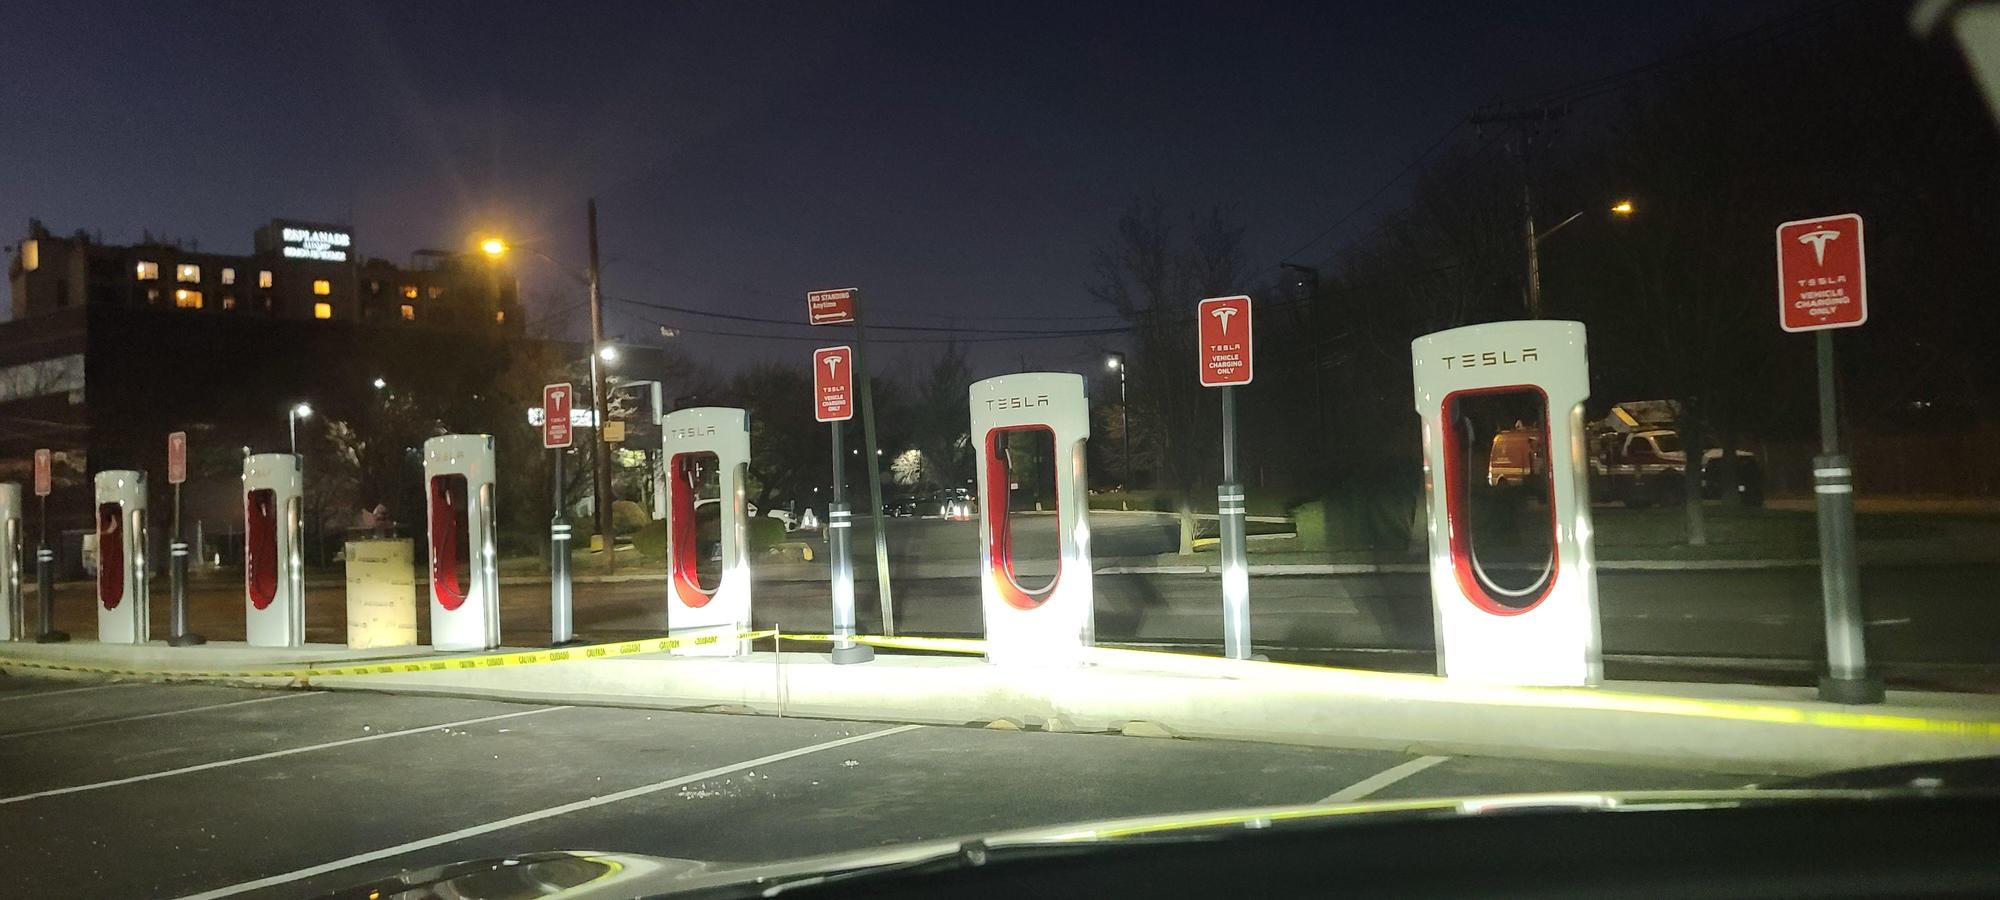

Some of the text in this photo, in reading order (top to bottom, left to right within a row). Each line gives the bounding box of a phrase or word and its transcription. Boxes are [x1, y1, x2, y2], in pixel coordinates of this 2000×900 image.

[283, 228, 350, 247] ESPLANADE
[1798, 275, 1846, 287] TESLA
[821, 292, 850, 301] STANDING
[1800, 289, 1844, 300] VEHICLE
[1795, 297, 1850, 309] CHARGING
[1809, 306, 1837, 316] ONLY
[1208, 360, 1243, 368] CHARGING
[1212, 354, 1239, 362] VEHICLE
[1442, 348, 1538, 370] TESLA
[986, 395, 1049, 412] TESLA
[672, 426, 715, 439] TESLA
[518, 655, 537, 664] CAUTION
[550, 651, 569, 661] CUIDADO
[586, 648, 606, 658] CAUTION
